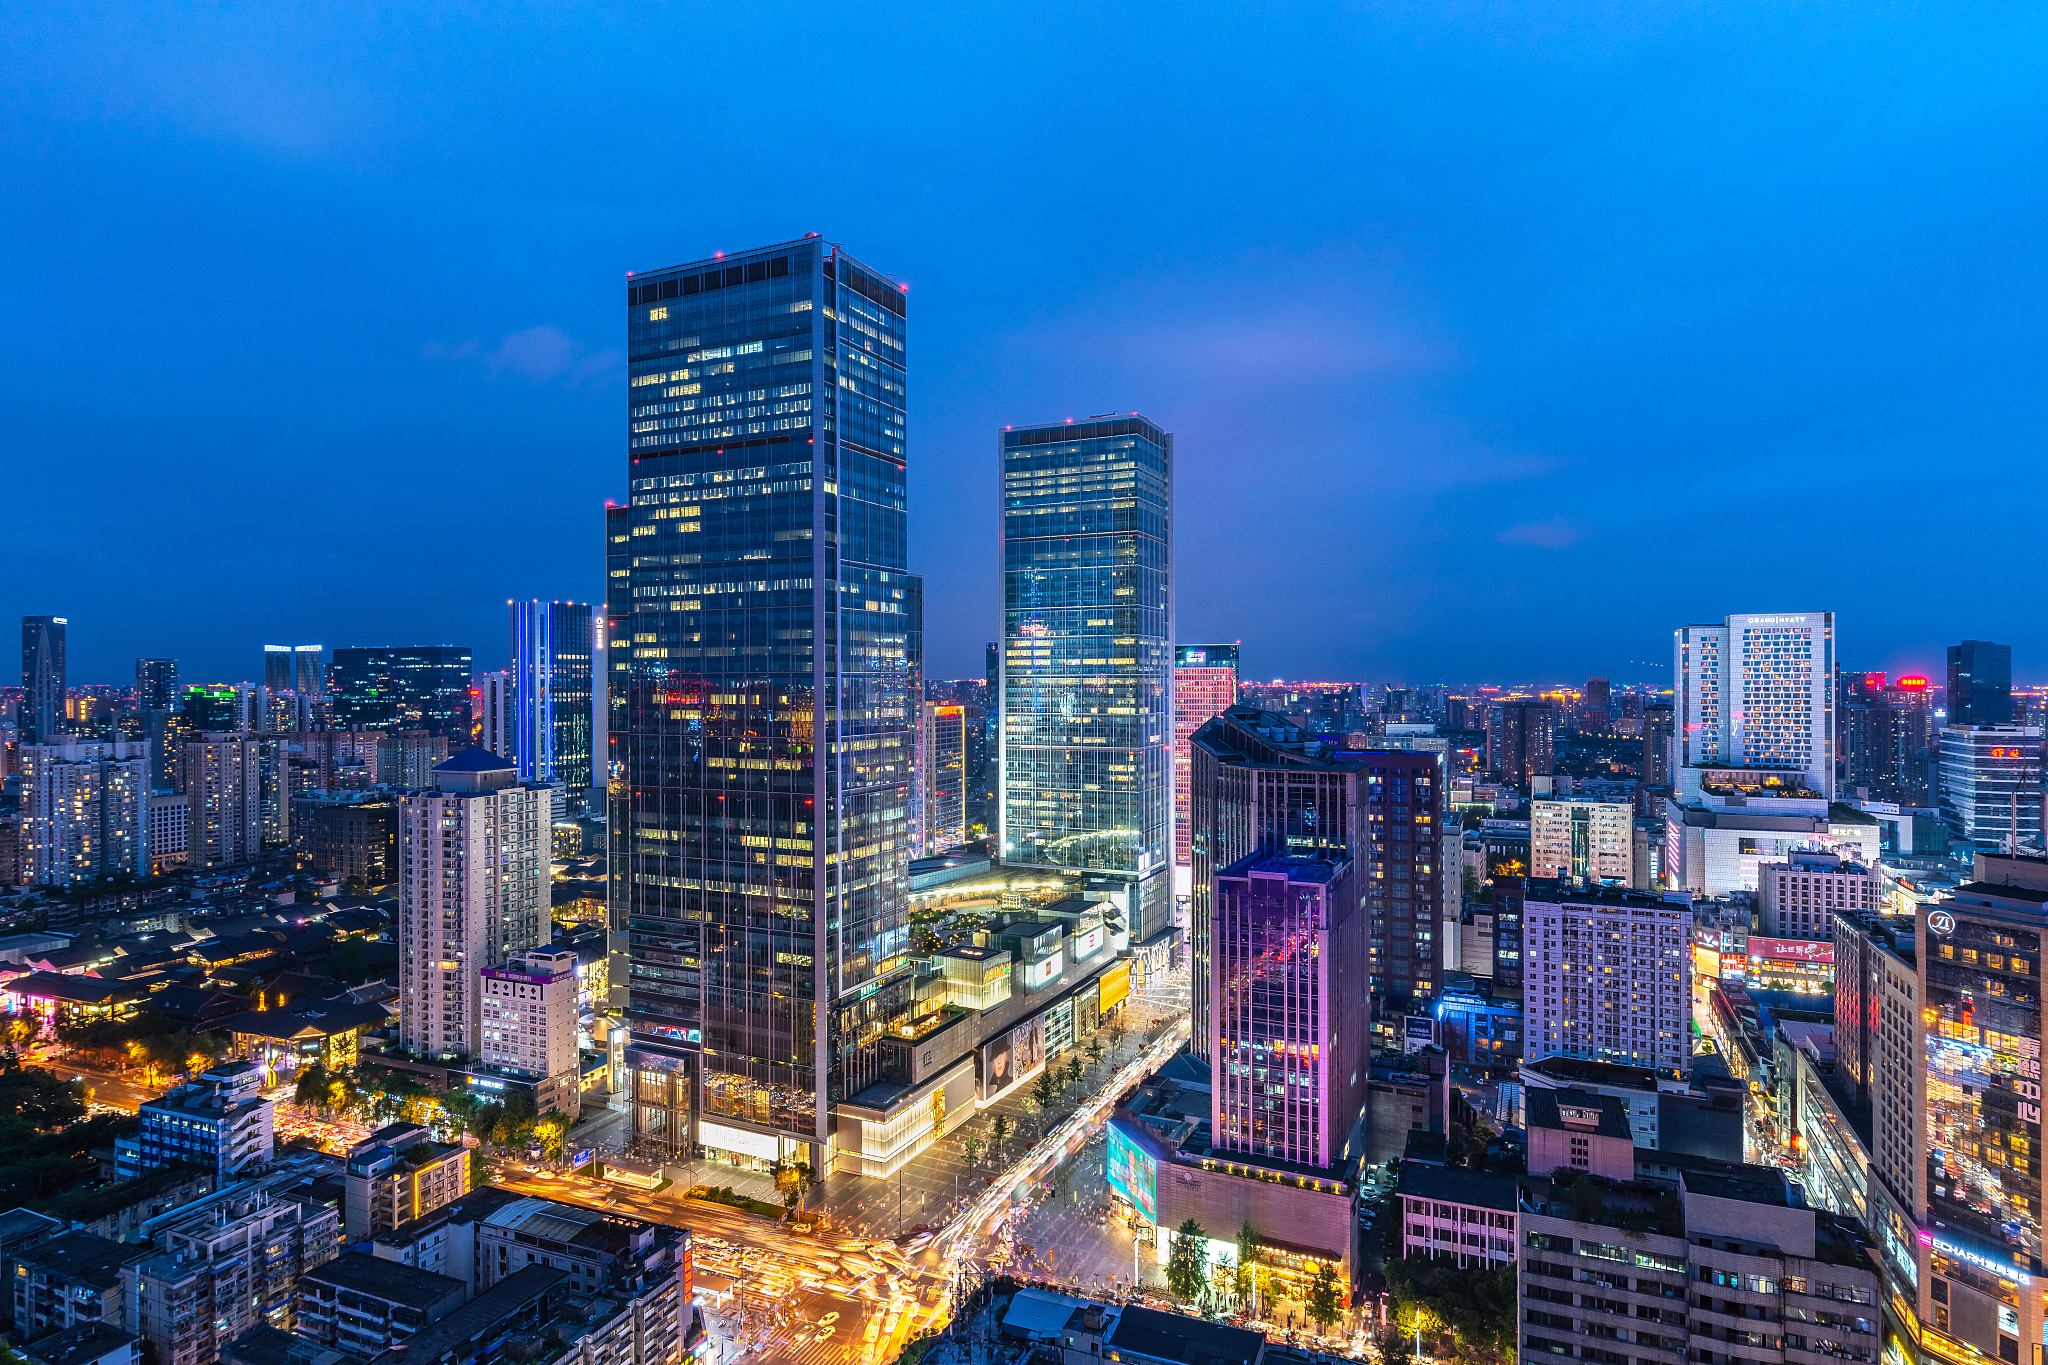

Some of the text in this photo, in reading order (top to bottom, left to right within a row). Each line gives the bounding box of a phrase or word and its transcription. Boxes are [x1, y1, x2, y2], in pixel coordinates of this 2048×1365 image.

[2018, 1036, 2040, 1124] 春熙中心
[1933, 1238, 1985, 1267] ECHARM
